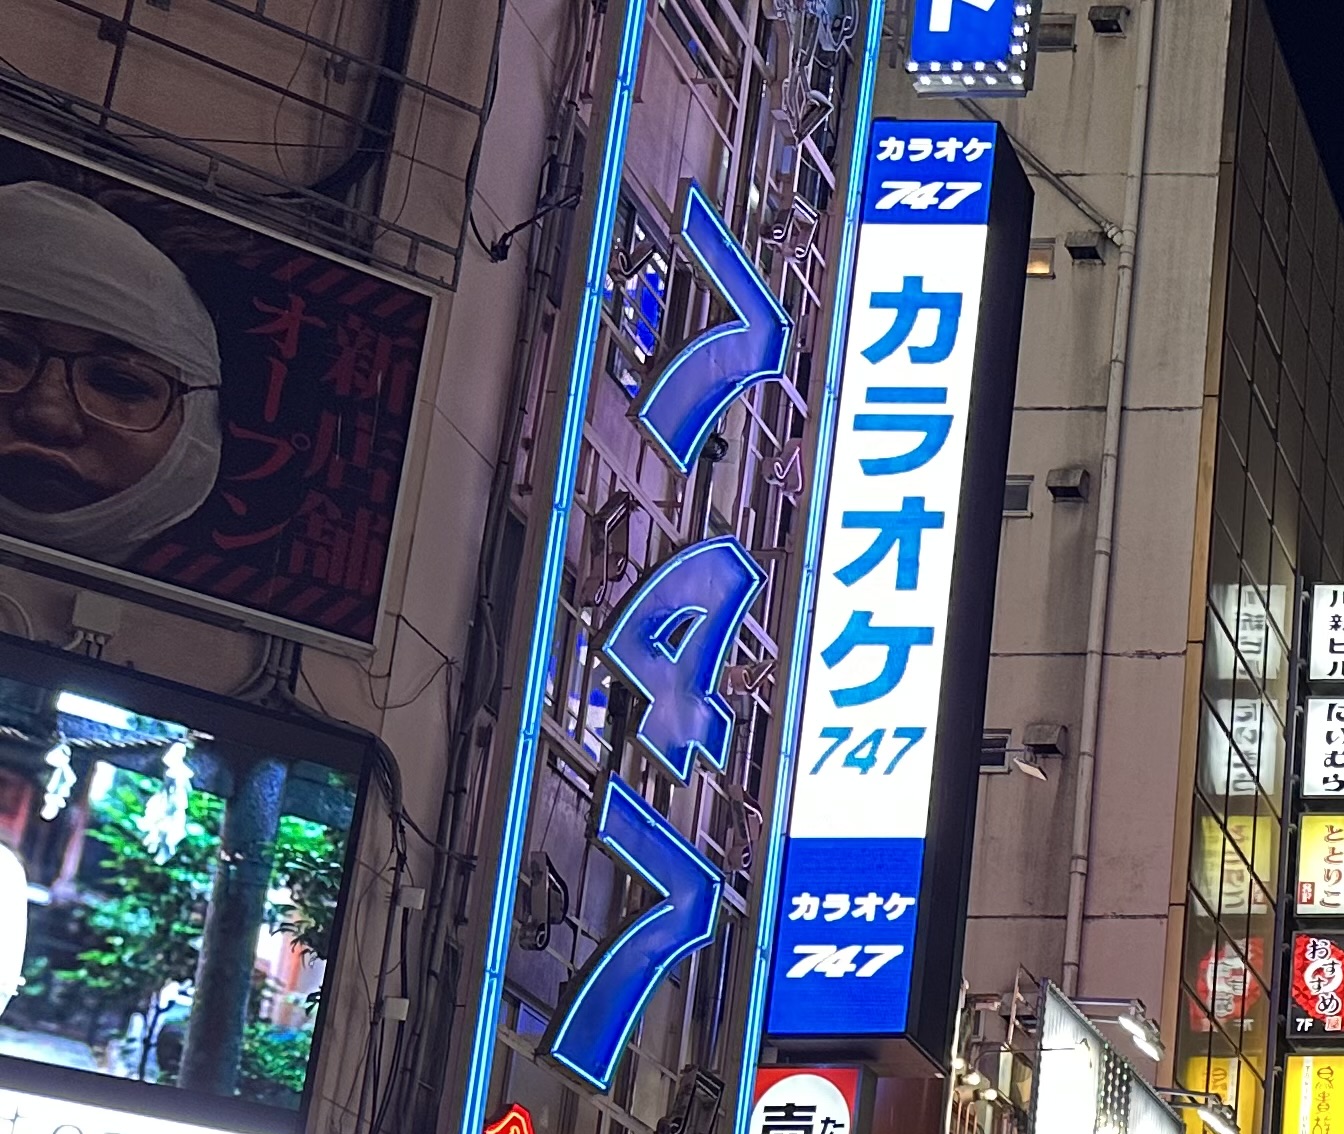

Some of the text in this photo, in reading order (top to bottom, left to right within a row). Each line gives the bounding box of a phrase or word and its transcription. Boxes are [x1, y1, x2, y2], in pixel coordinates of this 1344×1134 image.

[876, 137, 992, 163] カラオケ
[874, 181, 981, 210] 747
[213, 294, 328, 550] オープン
[820, 276, 962, 708] カラオケ
[810, 727, 926, 775] 747
[788, 893, 915, 921] カラオケ
[785, 946, 904, 978] 747
[1307, 939, 1342, 1014] おすすめ
[1296, 1018, 1313, 1032] 7F
